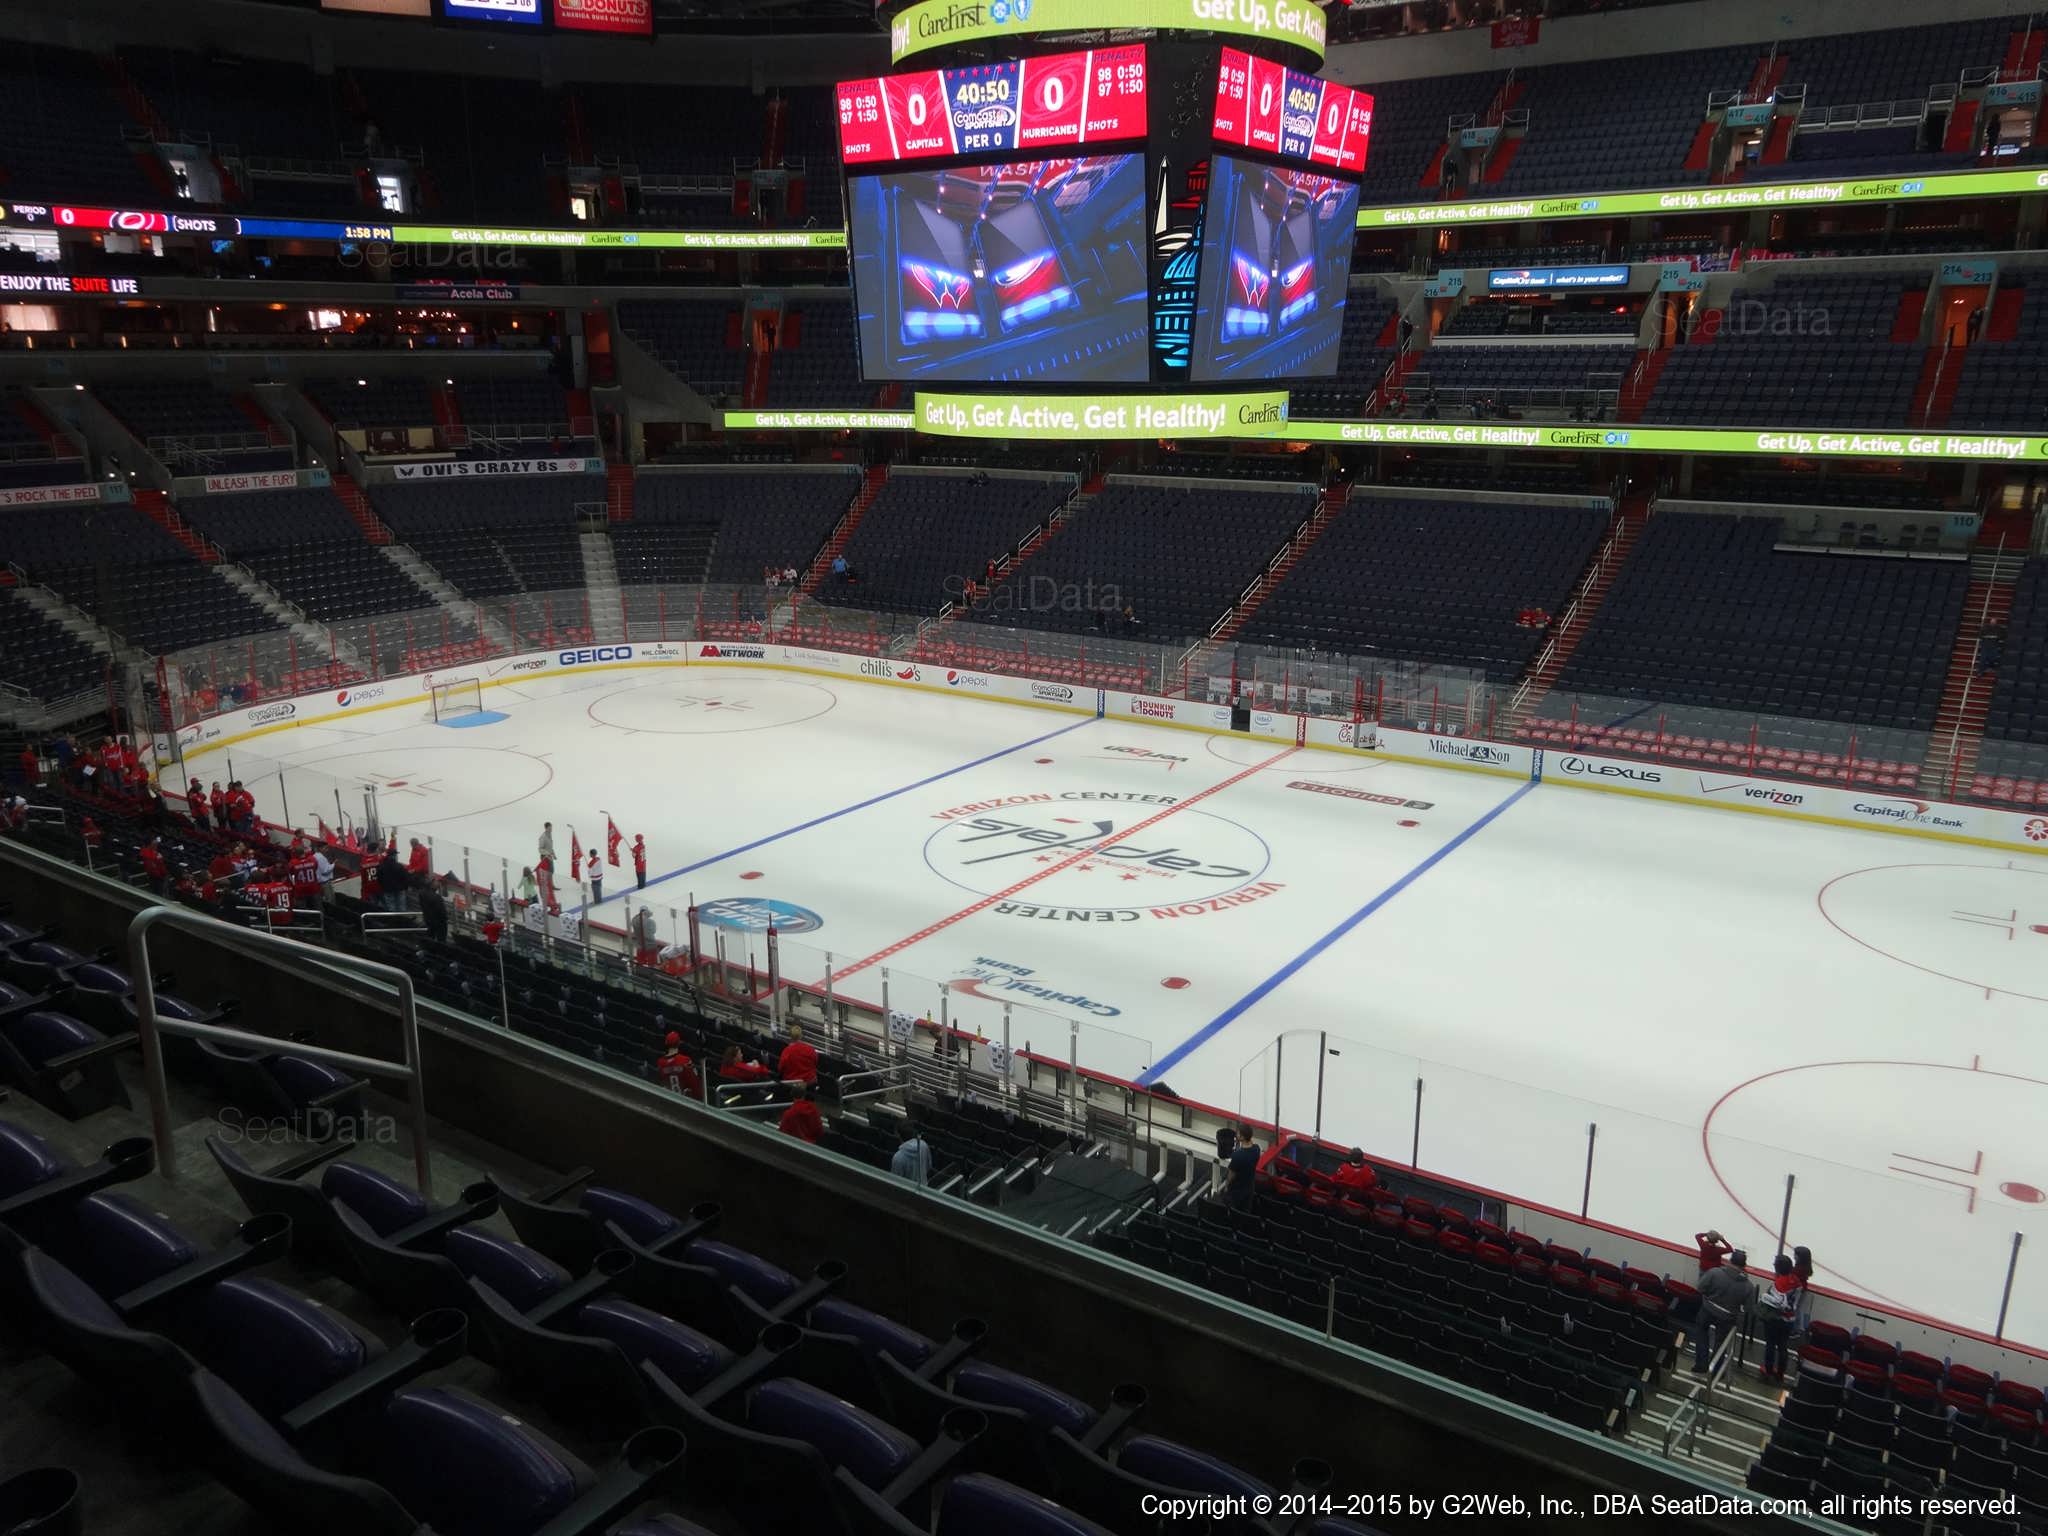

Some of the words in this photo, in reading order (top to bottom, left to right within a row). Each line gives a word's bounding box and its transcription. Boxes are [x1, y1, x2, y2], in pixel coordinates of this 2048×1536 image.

[919, 3, 986, 37] CareFirst
[1275, 1, 1301, 32] Get
[1098, 68, 1112, 82] 98
[1117, 64, 1143, 79] 0:50
[1231, 69, 1245, 85] 0:50
[956, 79, 1009, 104] 40:50
[1044, 77, 1064, 111] 0
[1098, 83, 1112, 97] 97
[1118, 79, 1143, 94] 1:50
[1219, 82, 1227, 95] 97
[1230, 85, 1244, 99] 1:50
[840, 98, 851, 111] 98
[856, 95, 877, 109] 0:50
[1260, 83, 1272, 116] 0
[1288, 88, 1316, 113] 40:50
[841, 112, 853, 124] 97
[857, 109, 878, 123] 1:50
[908, 94, 927, 126] 0
[1088, 119, 1118, 131] SHOTS
[1215, 118, 1233, 131] SHOTS
[1328, 104, 1338, 135] 0
[1022, 124, 1078, 139] HURRICANES
[1253, 129, 1275, 143] CAPITALS
[845, 144, 871, 154] SHOTS
[906, 137, 943, 150] CAPITALS
[964, 134, 989, 149] PER
[994, 133, 1002, 146] 0
[1285, 138, 1298, 151] PER
[1660, 194, 1681, 207] Get
[1702, 191, 1722, 205] Get
[1763, 188, 1785, 201] Get
[1789, 185, 1843, 201] Healthy!
[1852, 183, 1898, 197] CareFirst
[12, 205, 46, 215] PERIOD
[1384, 210, 1401, 222] Get
[1418, 208, 1435, 220] Get
[1469, 205, 1487, 217] Get
[1490, 203, 1533, 217] Healthy!
[1541, 202, 1578, 213] CareFirst
[177, 218, 216, 231] SHOTS
[346, 227, 371, 238] 1:58
[373, 228, 391, 240] PM
[1, 275, 41, 291] ENJOY
[44, 276, 71, 291] THE
[72, 278, 109, 293] SUITE
[111, 279, 138, 293] LIFE
[451, 288, 483, 299] Acela
[486, 288, 513, 299] Club
[756, 413, 775, 425] Get
[794, 414, 812, 425] Get
[850, 414, 867, 426] Get
[870, 414, 912, 428] Healthy!
[926, 401, 944, 425] Get
[947, 403, 969, 431] Up,
[973, 404, 1005, 428] Get
[1009, 404, 1079, 431] Active,
[1084, 405, 1126, 428] Get
[1135, 404, 1226, 432] Healthy!
[1239, 402, 1280, 425] CareFirst
[1341, 424, 1363, 439] Get
[1364, 424, 1384, 442] Up,
[1386, 426, 1408, 440] Get
[1411, 426, 1452, 443] Active,
[1454, 427, 1477, 442] Get
[1481, 428, 1540, 446] Healthy!
[1550, 431, 1601, 444] CareFirst
[1757, 433, 1786, 450] Get
[1788, 434, 1813, 453] Up,
[1817, 435, 1847, 451] Get
[1850, 435, 1905, 454] Active,
[1907, 437, 1940, 453] Get
[1945, 438, 2027, 459] Healthy!
[423, 463, 469, 477] OVI'S
[474, 461, 530, 474] CRAZY
[537, 460, 558, 472] 8s
[208, 477, 248, 490] UNLEASH
[252, 475, 270, 487] THE
[273, 472, 296, 486] FURY
[16, 489, 46, 501] ROCK
[50, 488, 72, 499] THE
[76, 487, 97, 499] RED
[559, 646, 632, 665] GEICO
[719, 650, 765, 659] NETWORK
[513, 658, 547, 670] verizon
[860, 659, 892, 678] chili's
[960, 674, 989, 688] pepsi
[353, 687, 384, 702] pepsi
[1143, 700, 1175, 711] DUNKIN'
[1143, 709, 1174, 719] DONUTS
[1428, 739, 1470, 757] Michael
[1488, 748, 1510, 763] Son
[1587, 763, 1661, 783] LEXUS
[1291, 782, 1403, 806] CHIPOTLE
[1744, 787, 1803, 805] verizon
[930, 793, 1052, 821] VERIZON
[1060, 791, 1178, 806] CENTER
[1932, 816, 1964, 829] Bank
[1149, 881, 1286, 920] VERIZON
[994, 902, 1141, 922] CENTER
[972, 957, 1035, 977] Bank
